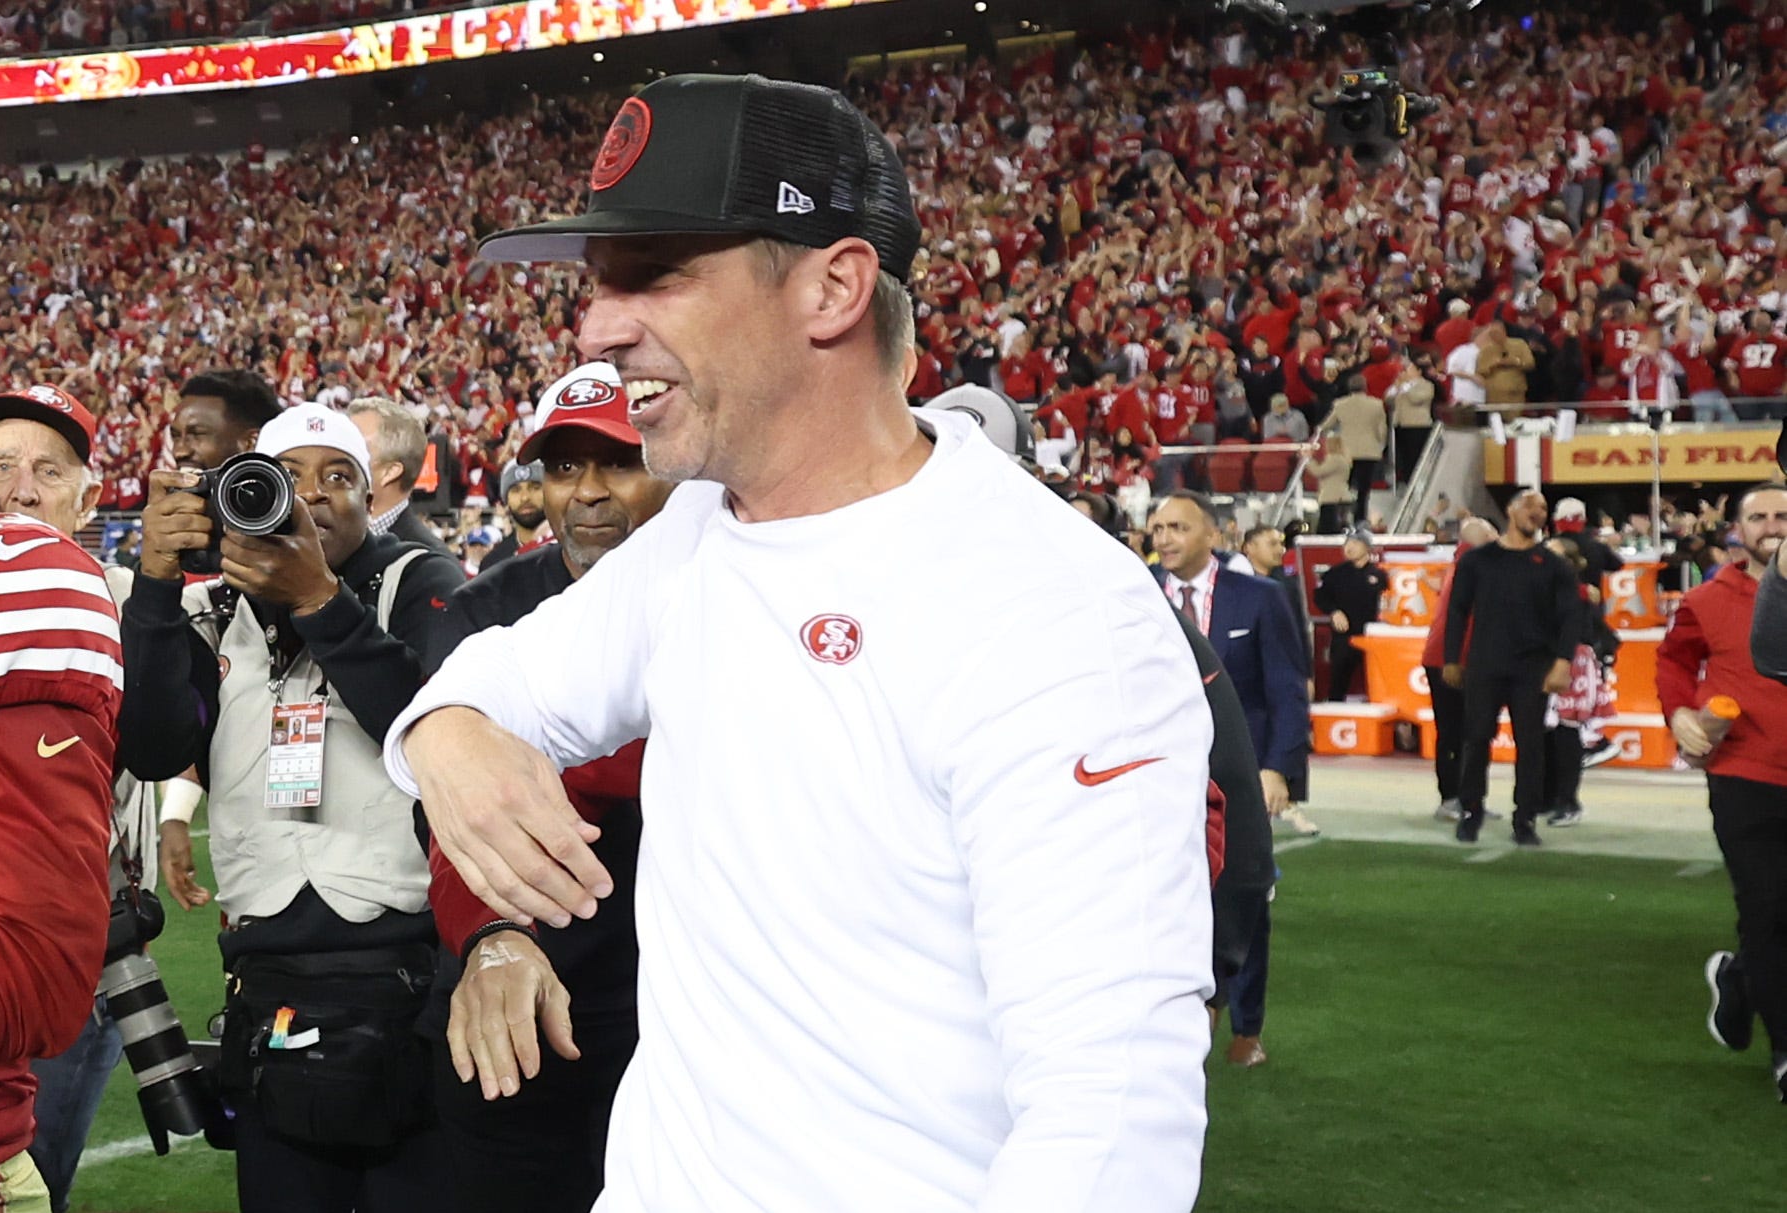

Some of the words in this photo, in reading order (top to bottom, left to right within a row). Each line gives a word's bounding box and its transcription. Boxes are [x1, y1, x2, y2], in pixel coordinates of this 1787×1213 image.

[351, 12, 487, 71] NFC
[1743, 343, 1777, 368] 97
[1571, 448, 1669, 467] SAN
[1395, 570, 1419, 597] G
[1610, 569, 1637, 597] G
[1330, 719, 1358, 749] G
